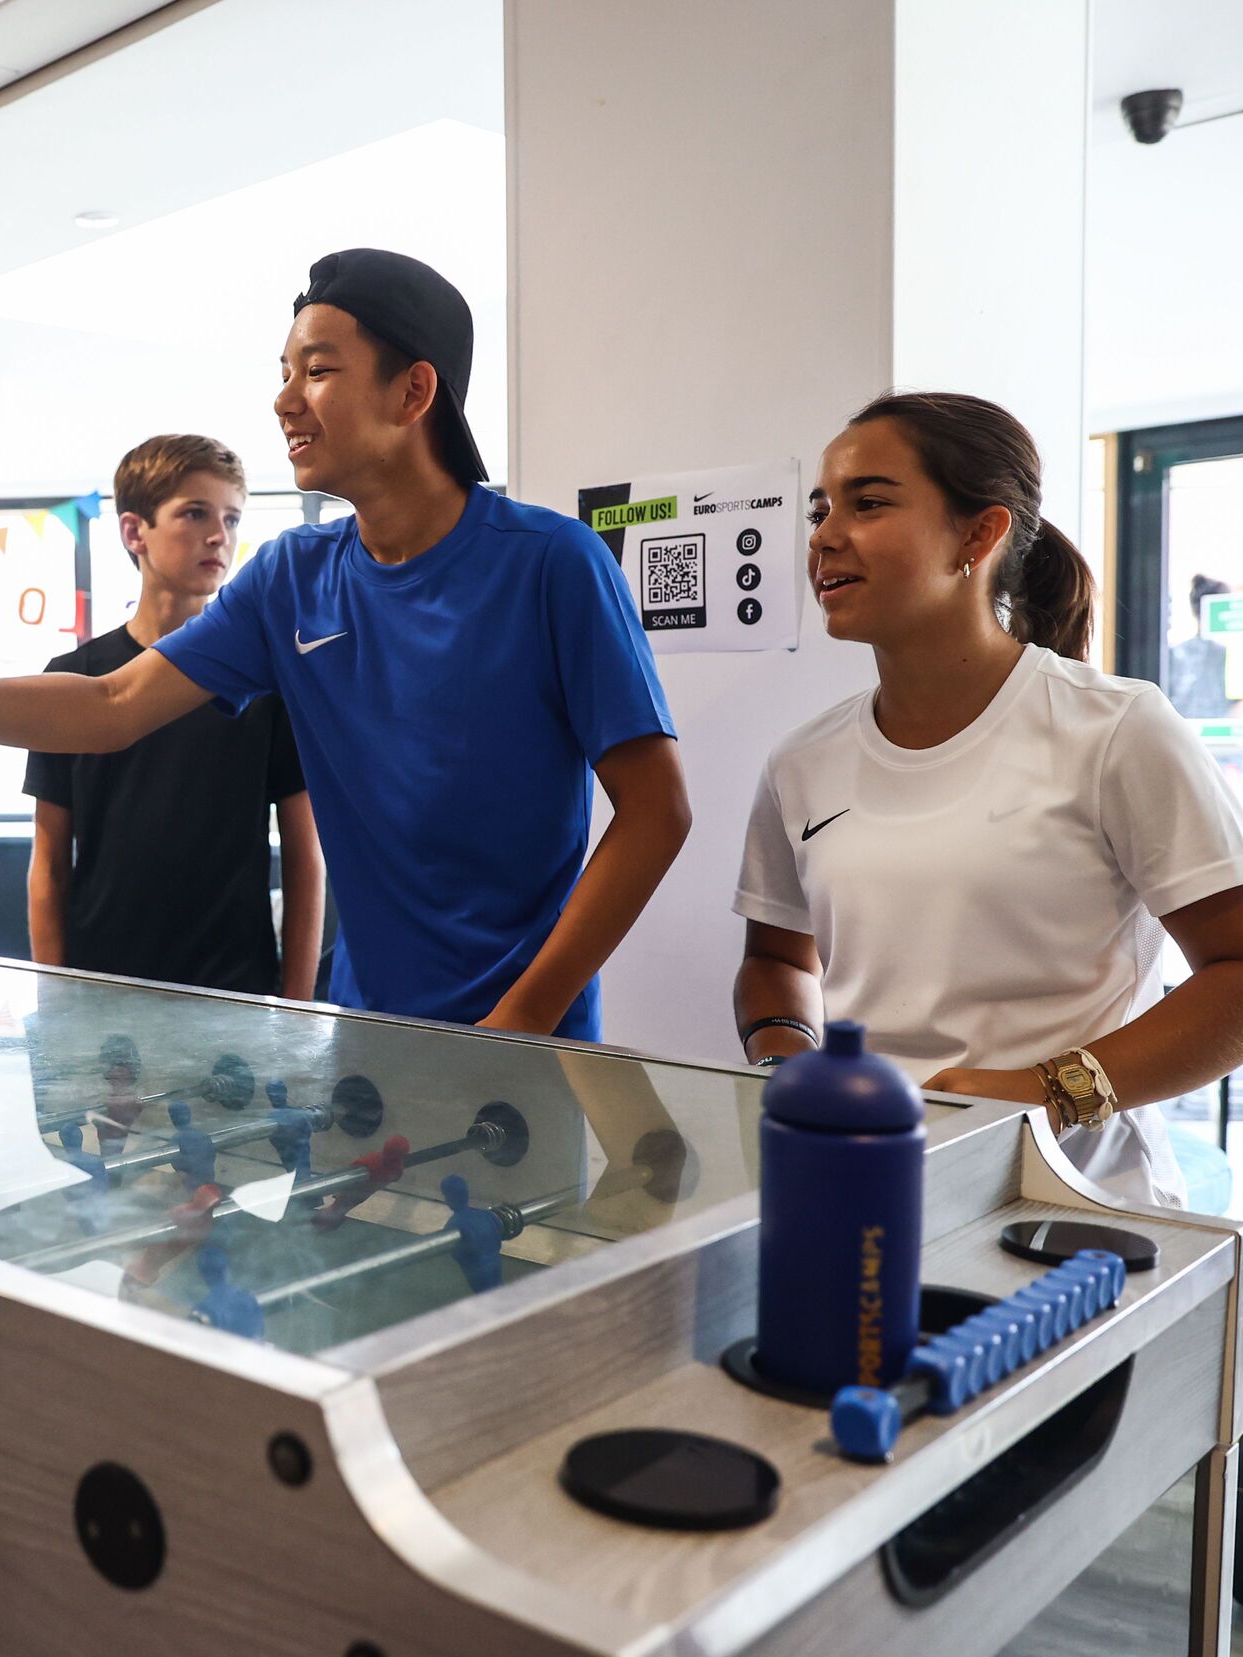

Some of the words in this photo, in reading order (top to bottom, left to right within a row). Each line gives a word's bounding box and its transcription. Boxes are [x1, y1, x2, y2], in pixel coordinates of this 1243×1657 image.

[598, 506, 647, 527] FOLLOW
[650, 502, 672, 521] US!
[693, 496, 783, 516] EUROSPORTSCAMPS
[652, 614, 678, 627] SCAN
[680, 613, 696, 625] ME
